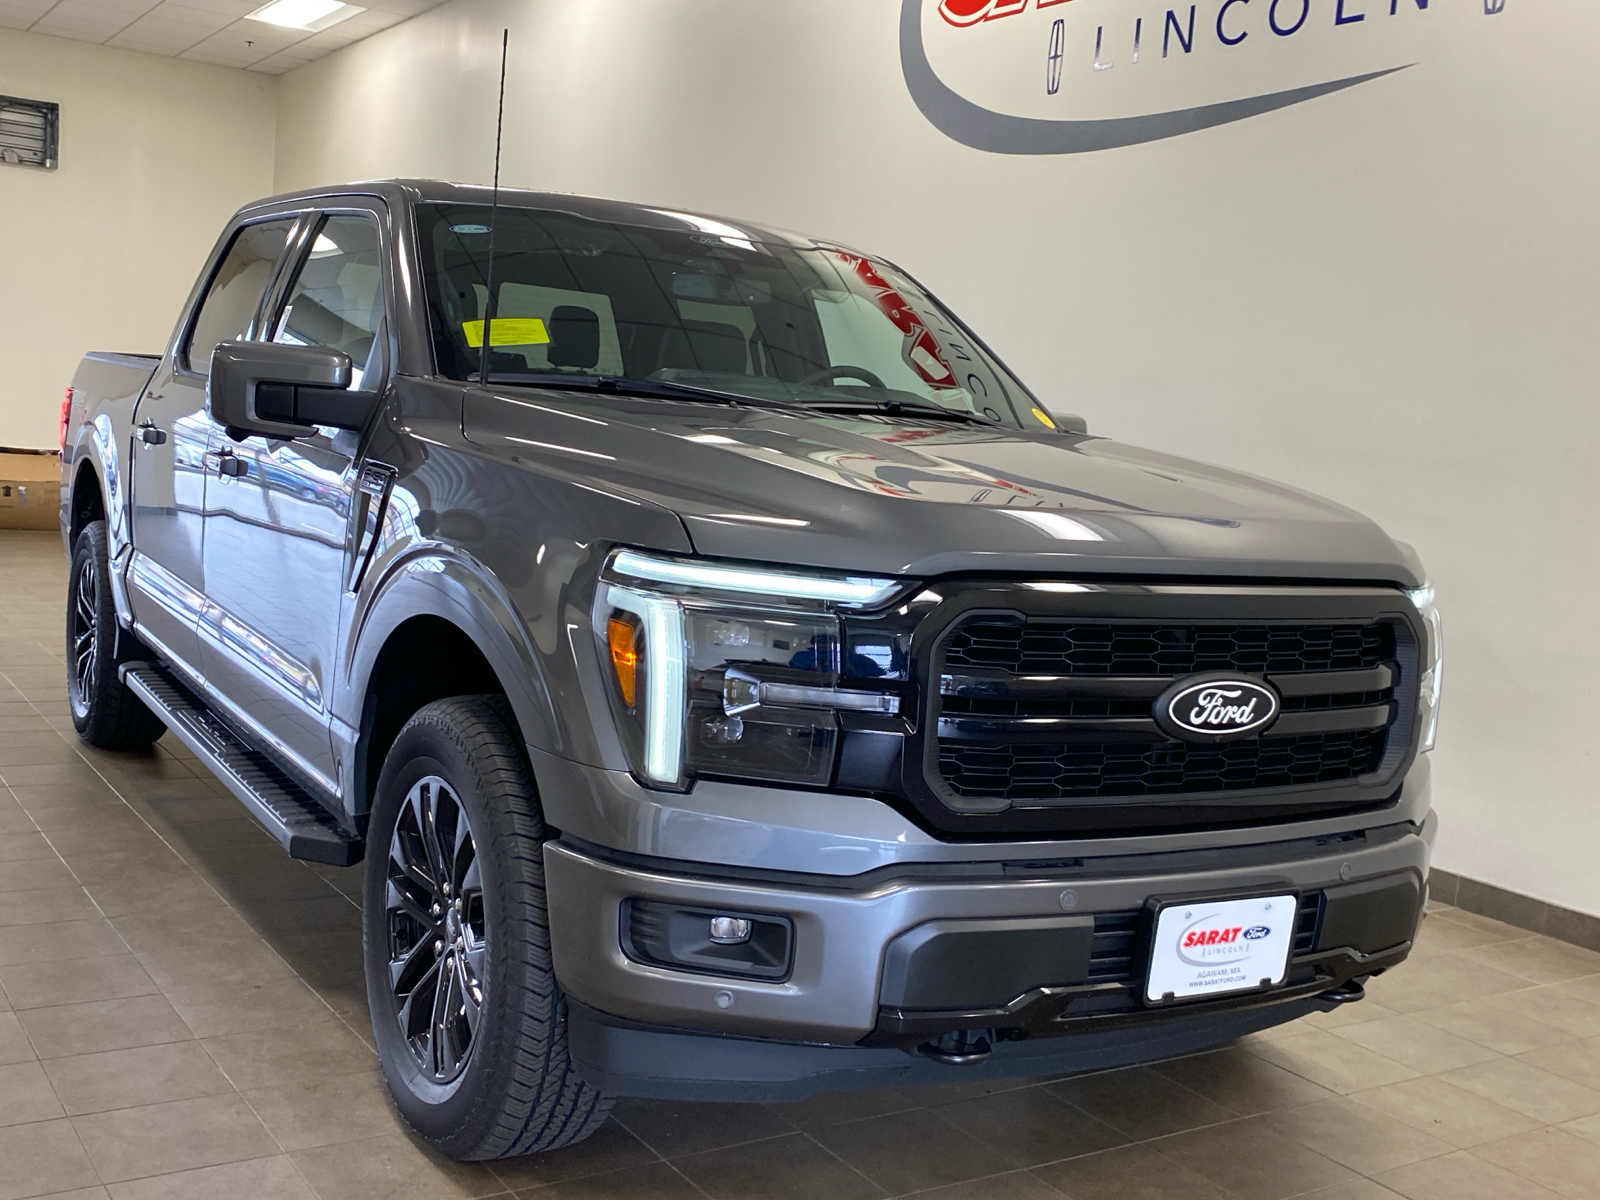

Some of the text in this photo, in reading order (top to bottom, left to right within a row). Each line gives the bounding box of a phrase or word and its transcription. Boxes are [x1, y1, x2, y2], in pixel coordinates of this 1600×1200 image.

[1092, 0, 1428, 73] LINCOL
[1189, 688, 1258, 725] Ford
[1183, 926, 1269, 948] SARAT Ford
[1207, 945, 1244, 956] LINCOLN
[1188, 974, 1247, 988] WWW.SARATFORD.COM
[1197, 967, 1241, 979] AGAWAM, MA
